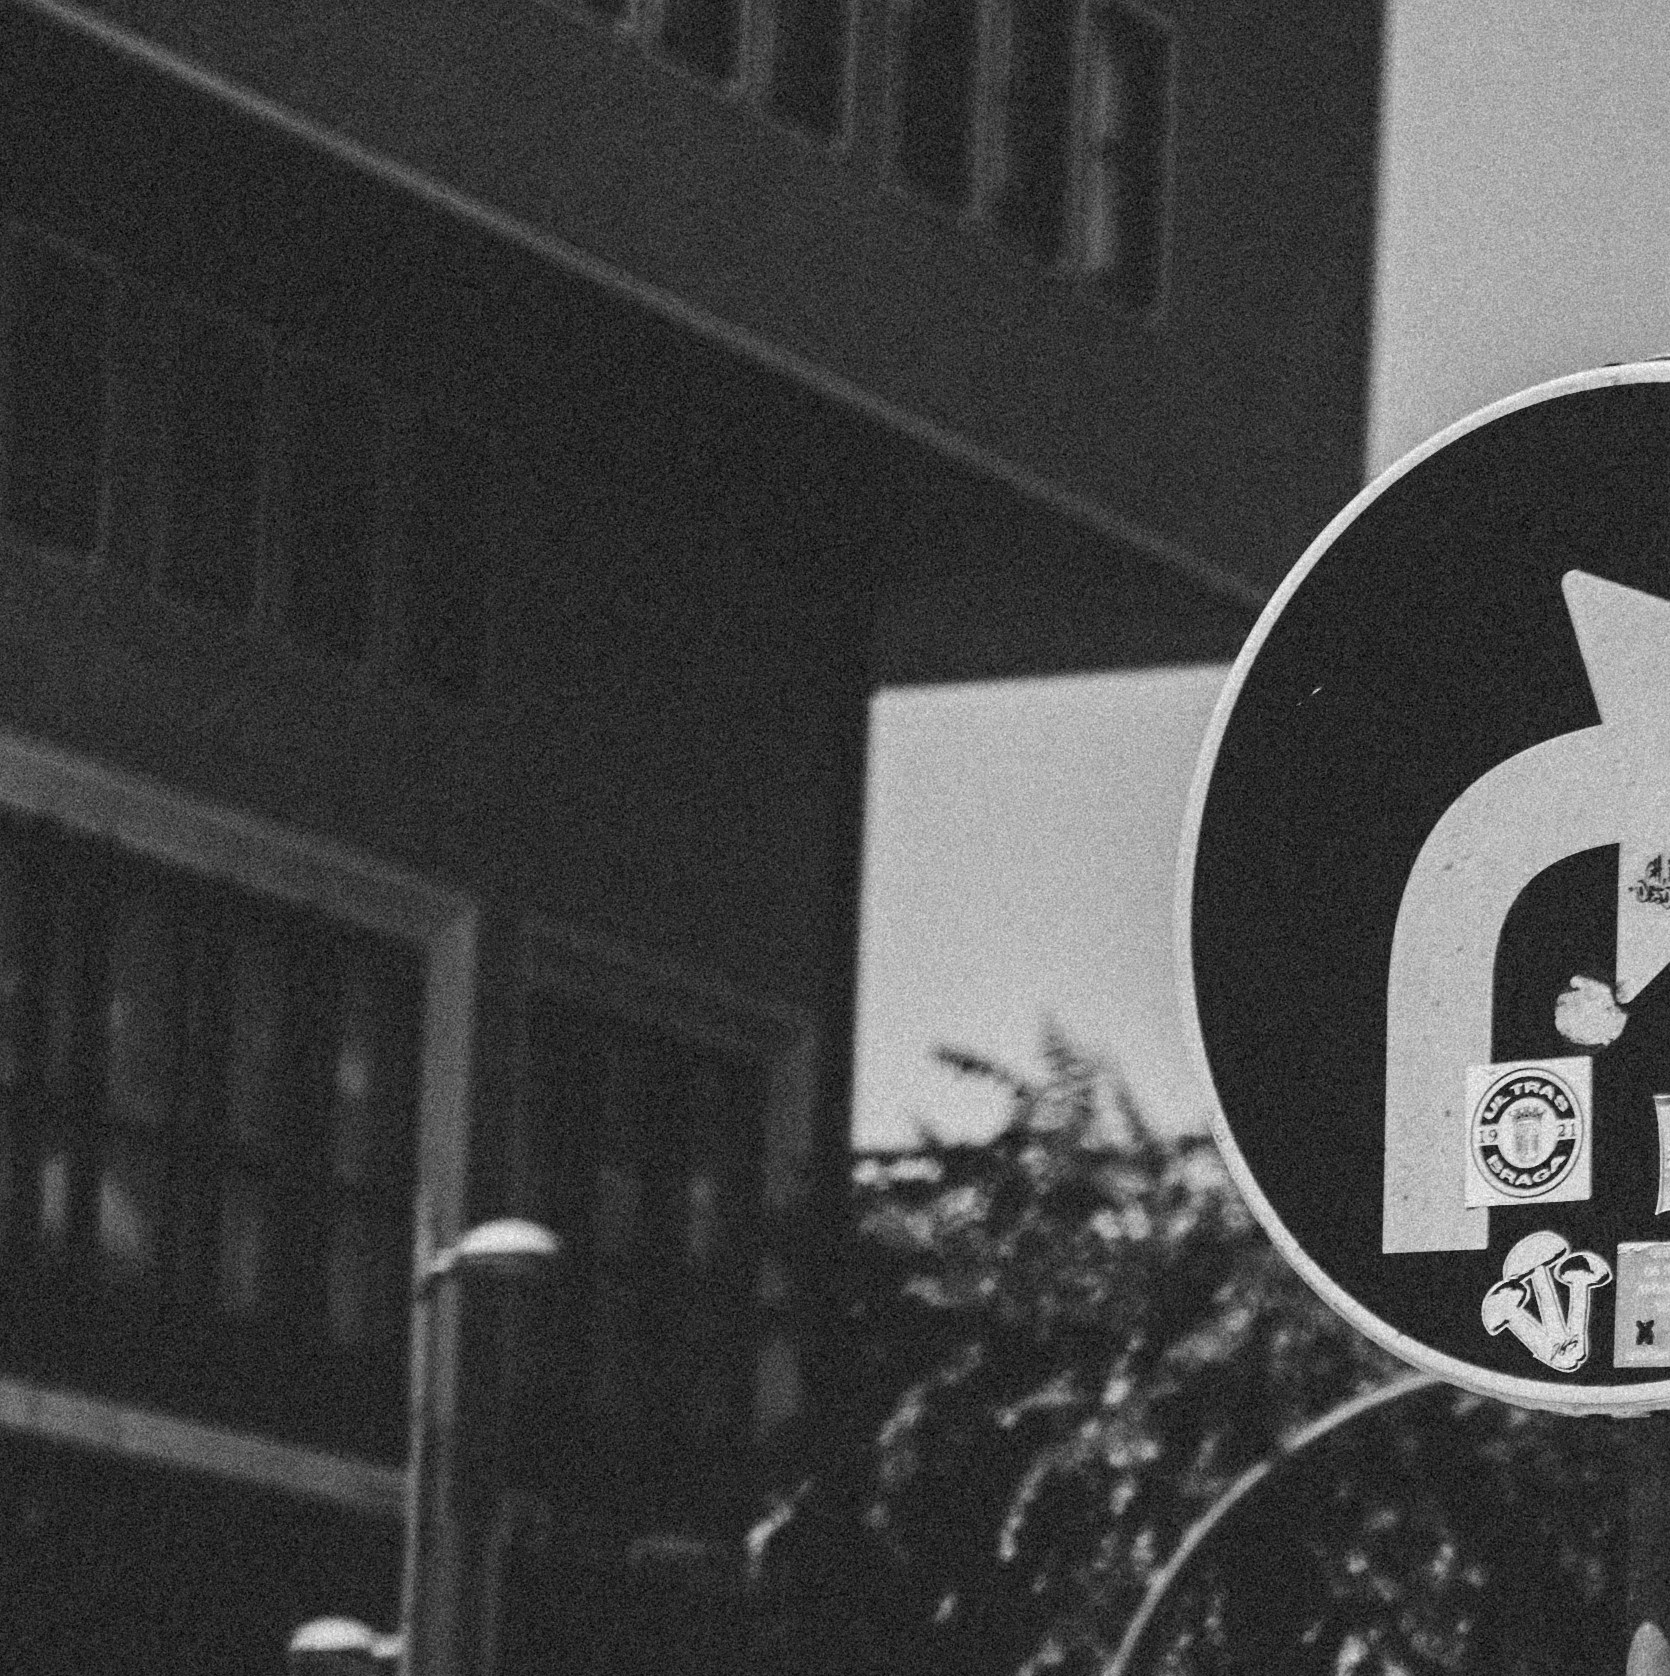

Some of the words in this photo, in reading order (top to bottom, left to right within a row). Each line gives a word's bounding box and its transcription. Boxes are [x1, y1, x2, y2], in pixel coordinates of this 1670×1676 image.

[1483, 1080, 1569, 1120] ULTRAS
[1479, 1129, 1498, 1144] 19
[1558, 1123, 1576, 1138] 21
[1486, 1154, 1568, 1186] BRAGA
